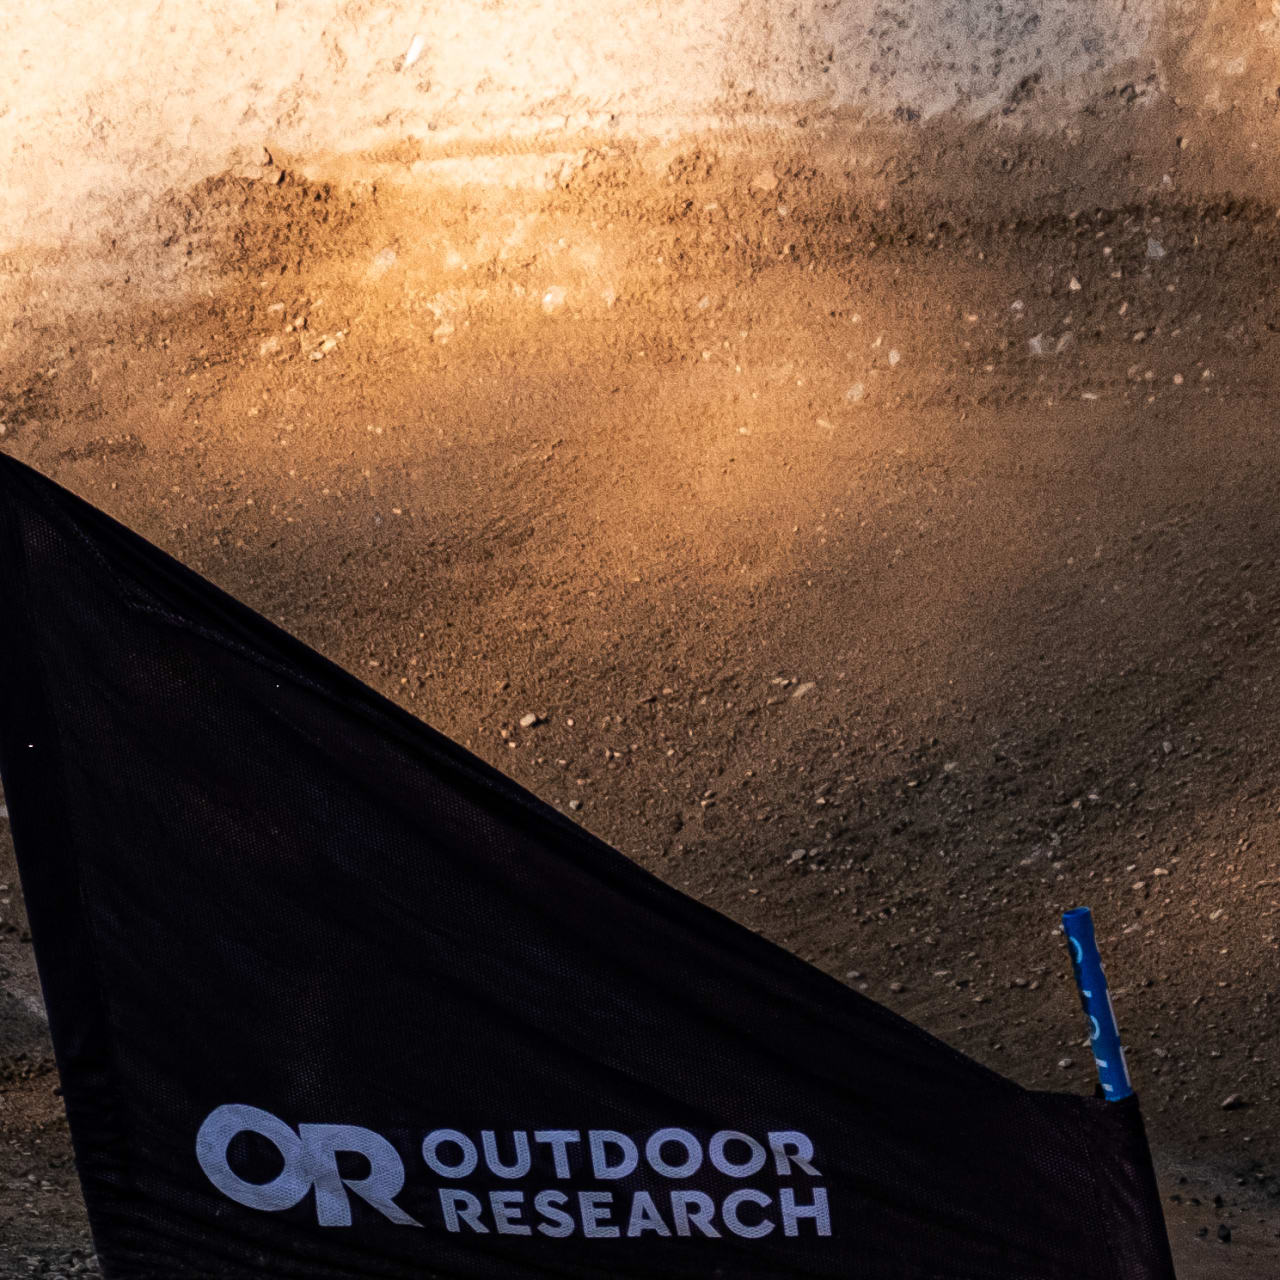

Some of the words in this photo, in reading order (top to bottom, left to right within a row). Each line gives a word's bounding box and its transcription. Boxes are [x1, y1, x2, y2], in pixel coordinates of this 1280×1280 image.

[196, 1104, 424, 1227] OR
[422, 1128, 822, 1179] OUTDOOR
[439, 1188, 832, 1238] RESEARCH
